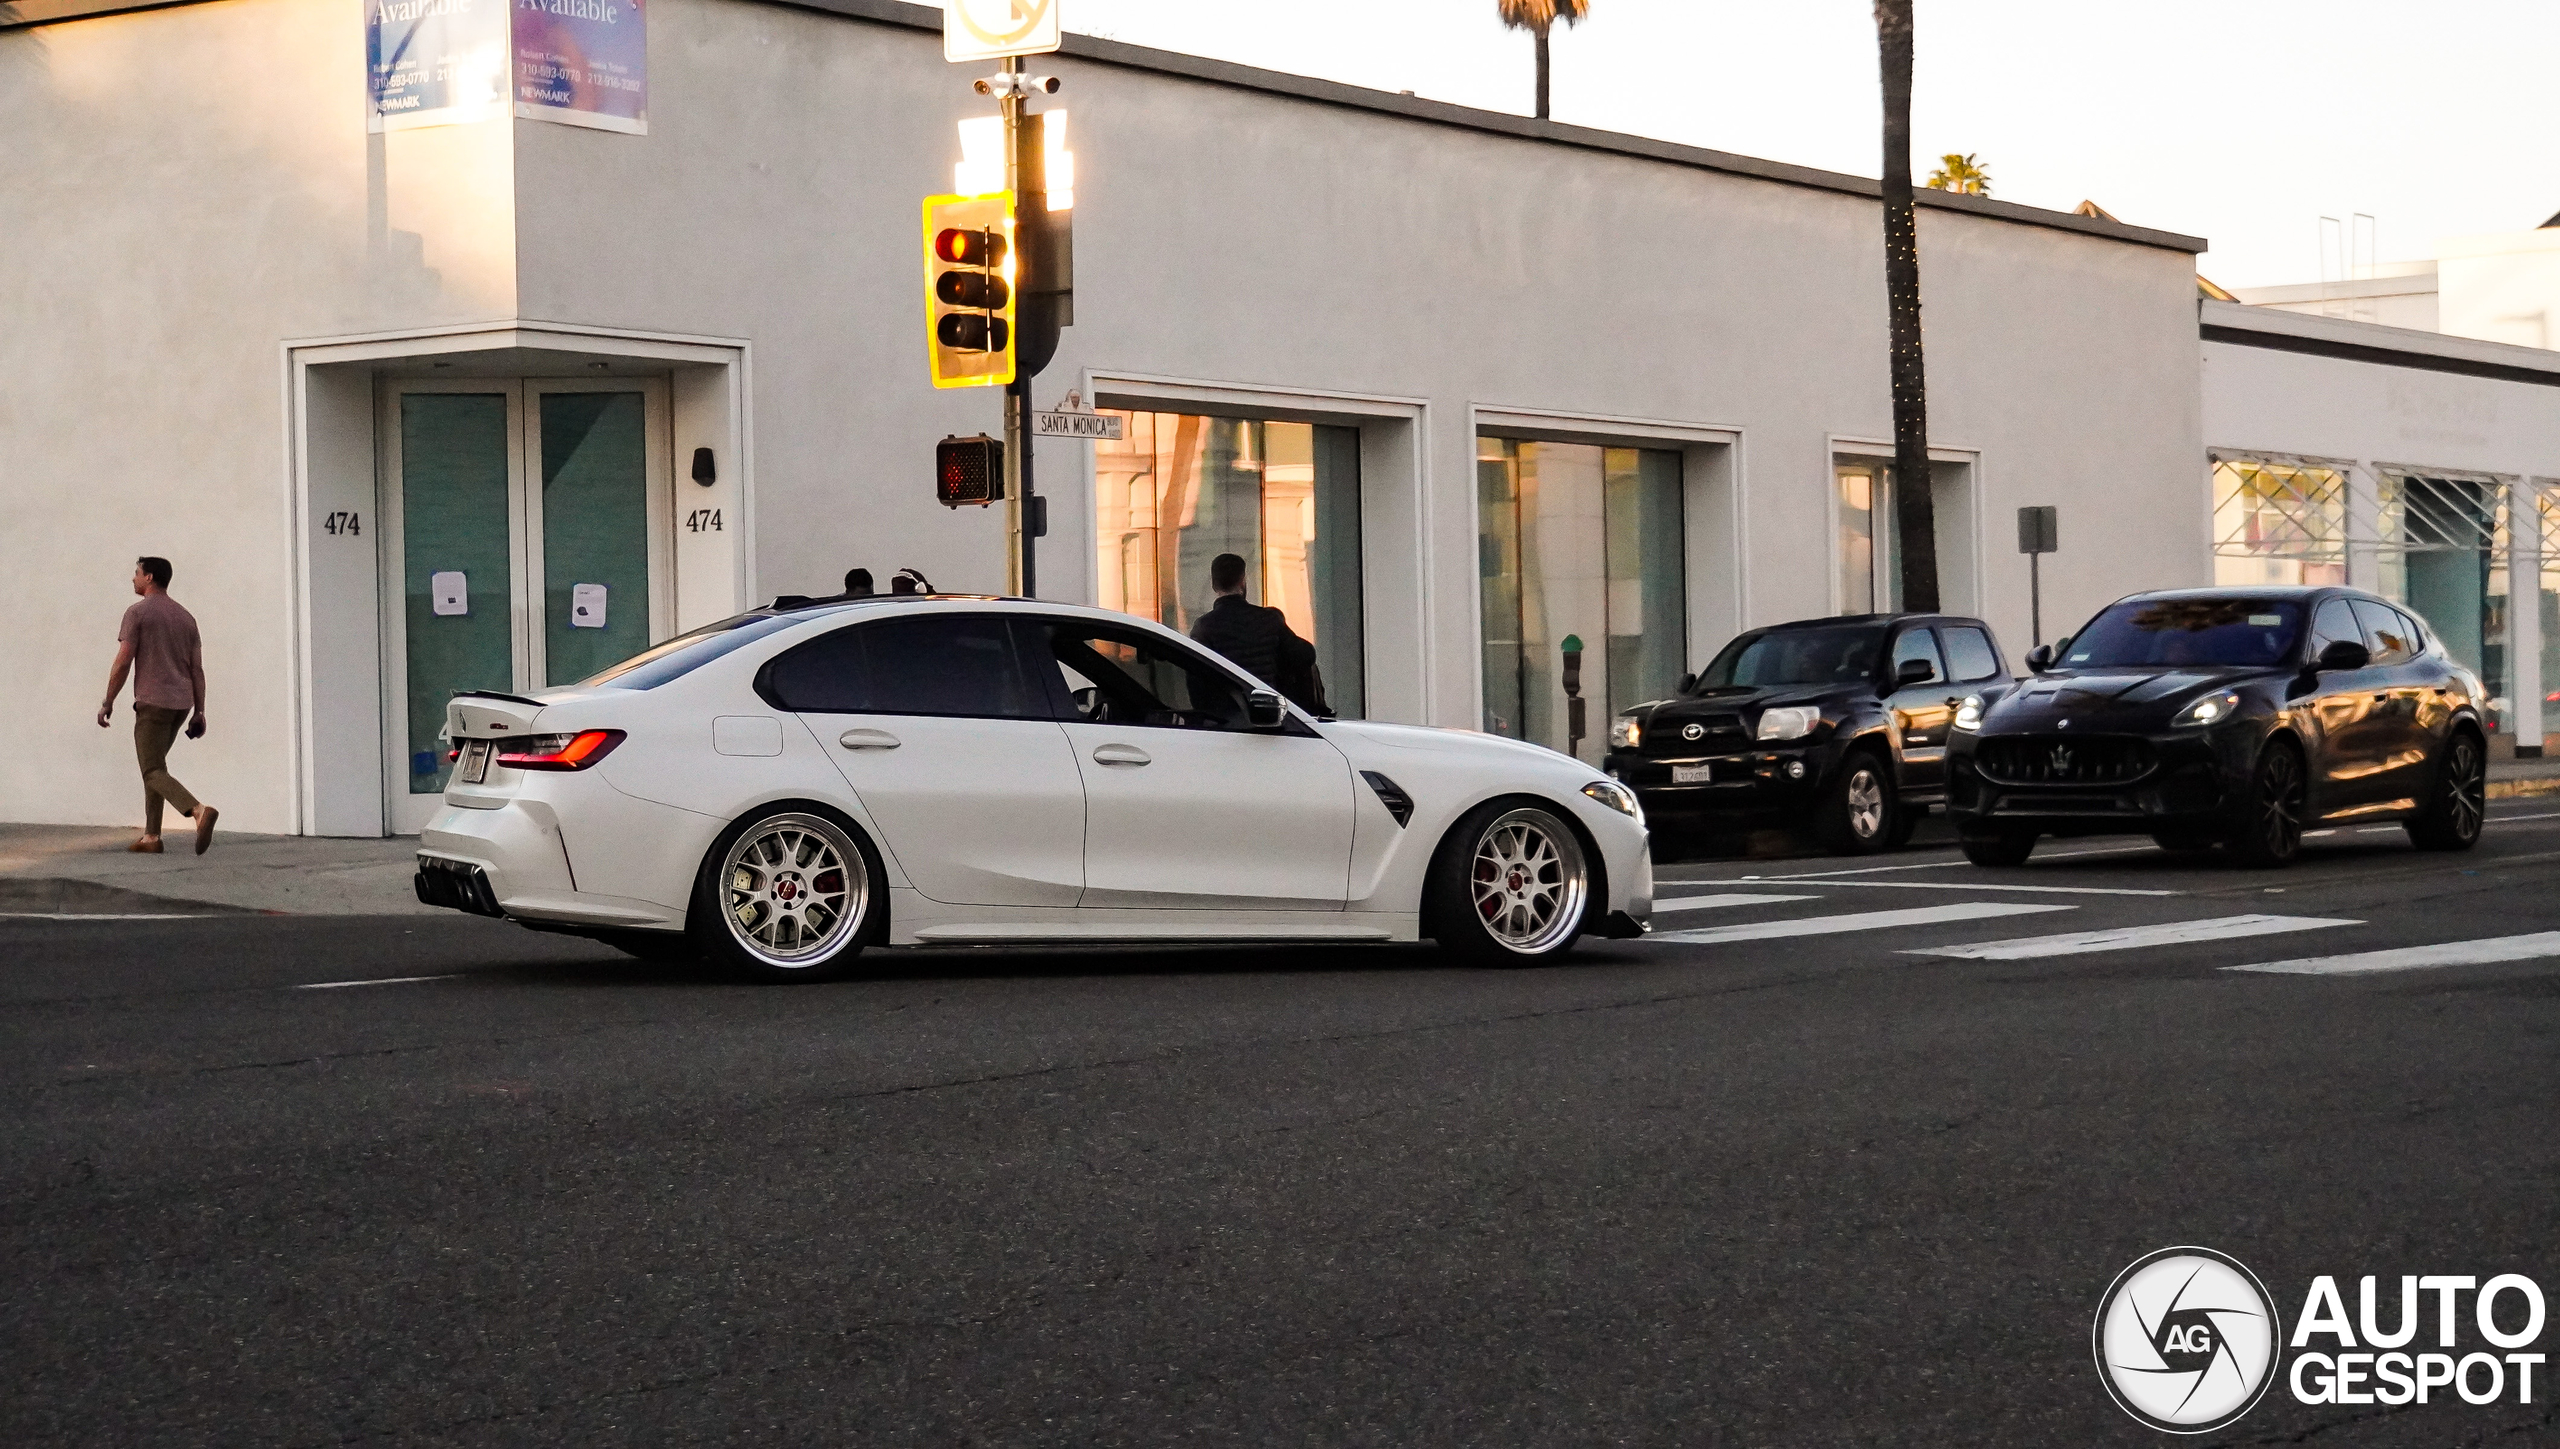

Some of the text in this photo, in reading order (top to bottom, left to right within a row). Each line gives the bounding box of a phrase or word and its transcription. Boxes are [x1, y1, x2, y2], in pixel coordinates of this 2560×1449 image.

[521, 86, 570, 104] NEWMARK
[1041, 415, 1069, 433] SANTA
[1073, 416, 1107, 435] MONICA
[324, 511, 361, 536] 474
[686, 508, 723, 532] 474
